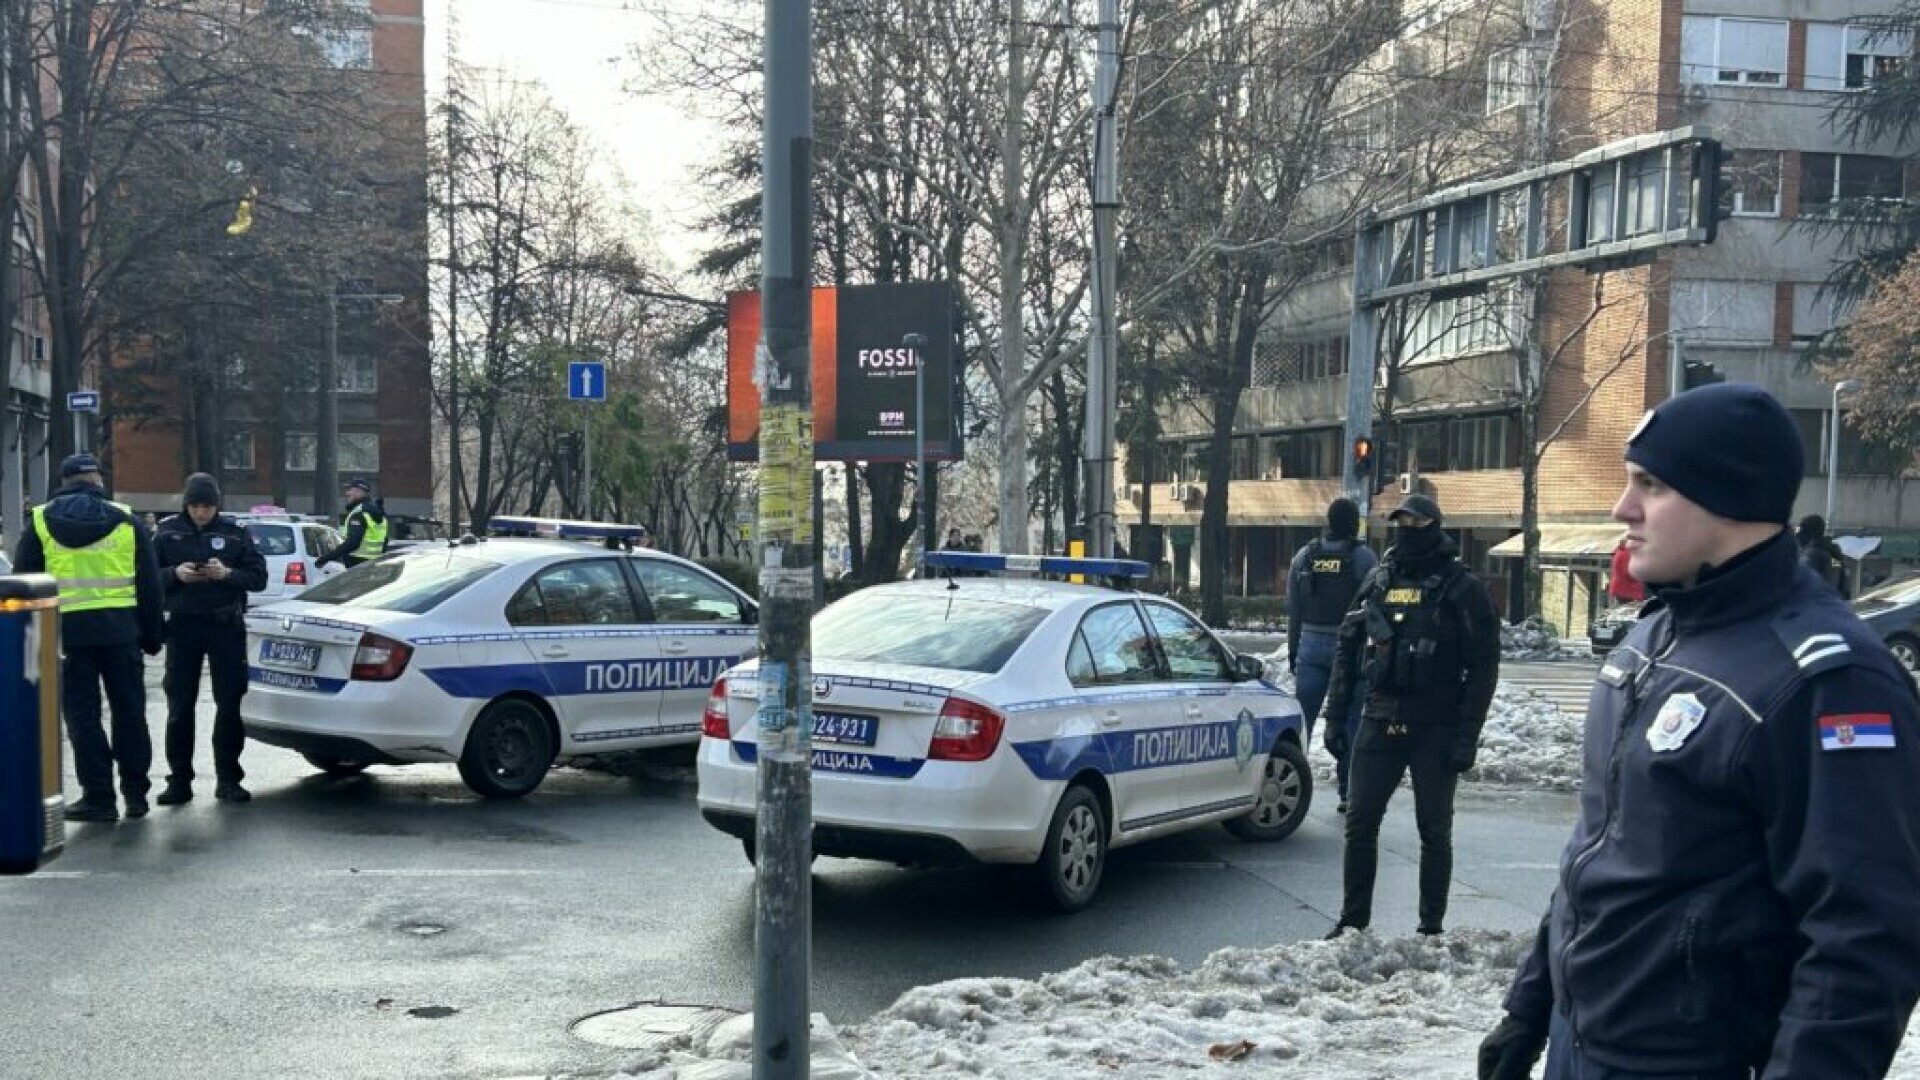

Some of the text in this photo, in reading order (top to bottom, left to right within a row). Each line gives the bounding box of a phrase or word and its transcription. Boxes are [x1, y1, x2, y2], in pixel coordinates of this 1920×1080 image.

[859, 348, 919, 368] FOSSI
[585, 659, 728, 691] ПОЛИЦИЈА
[1133, 725, 1229, 766] ПОЛИЦИЈА
